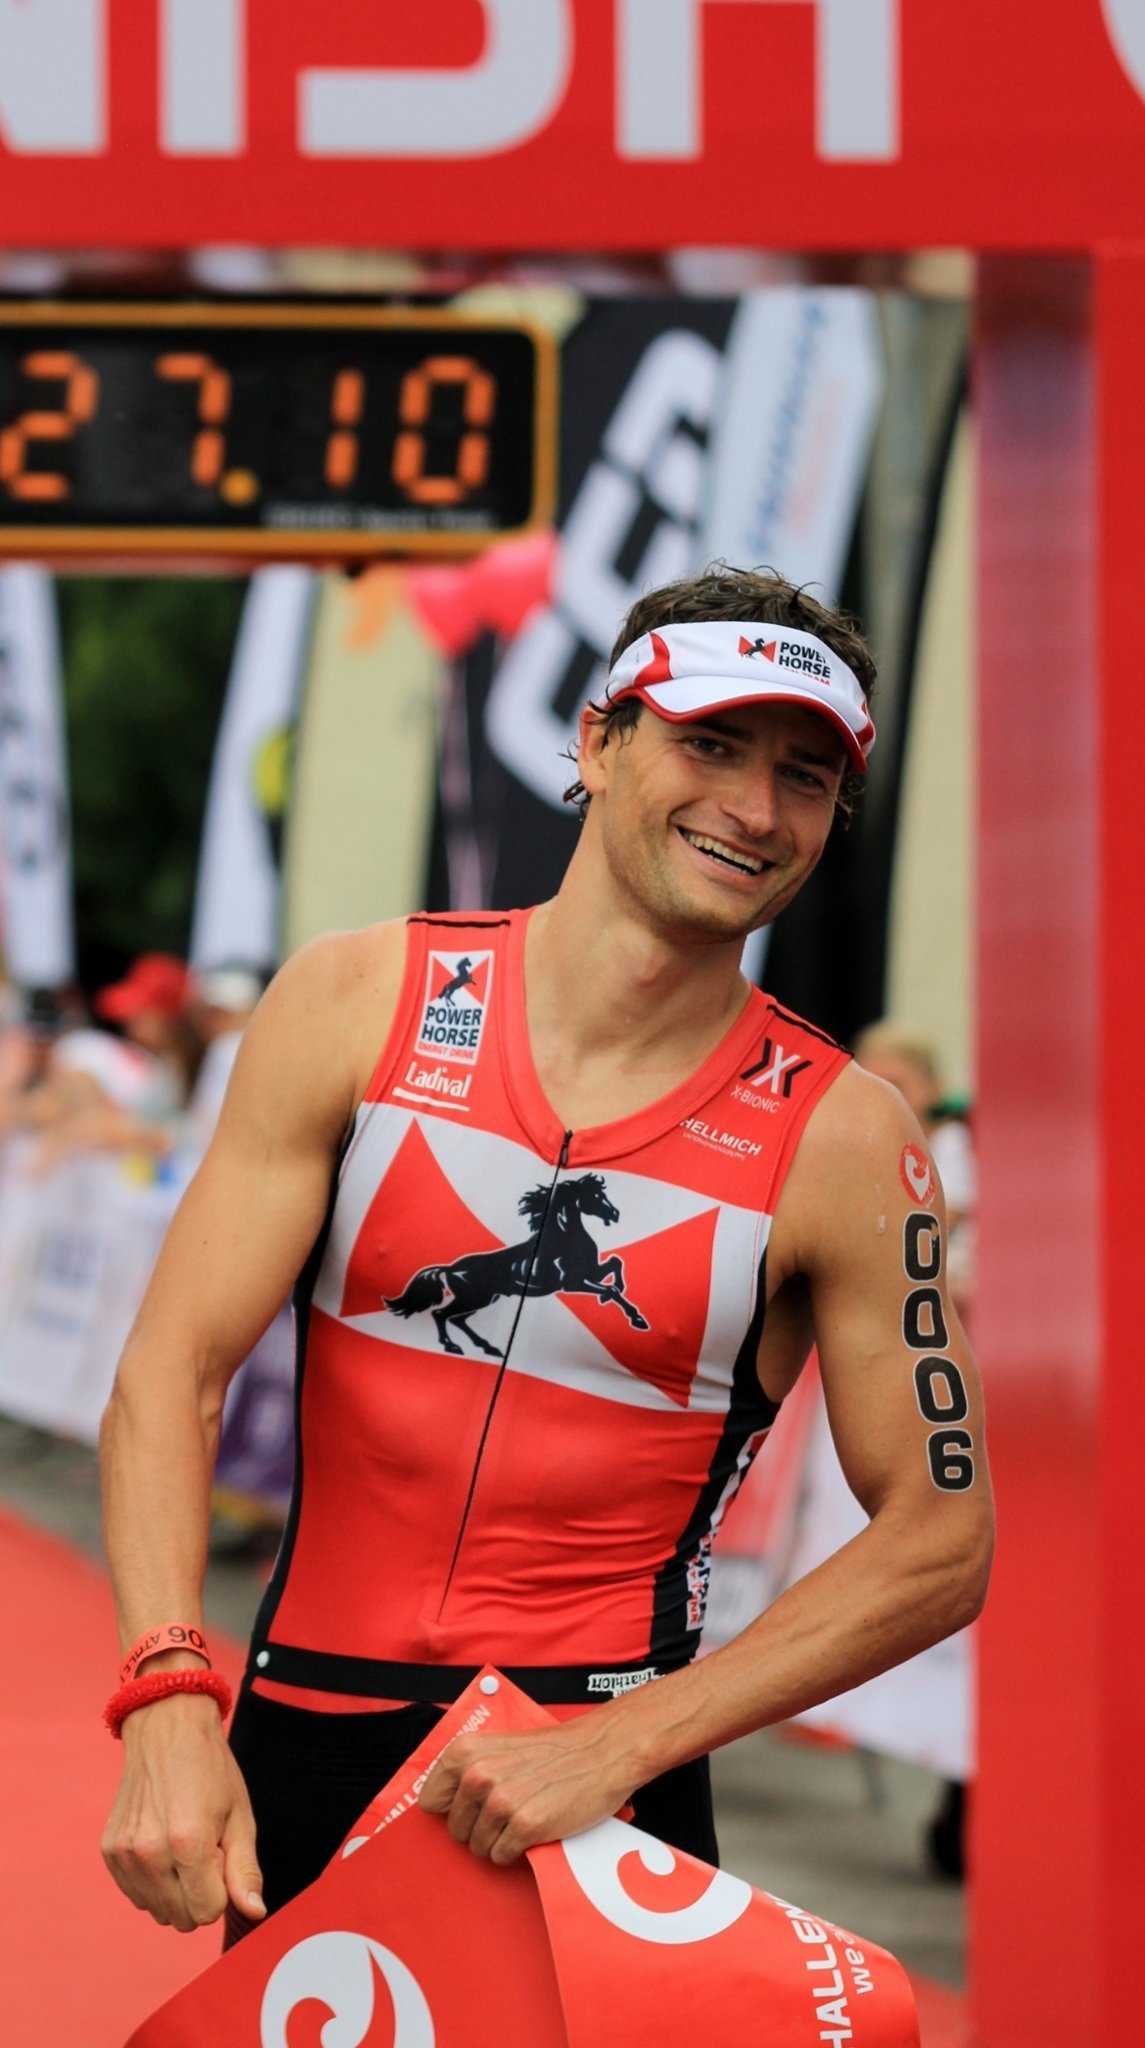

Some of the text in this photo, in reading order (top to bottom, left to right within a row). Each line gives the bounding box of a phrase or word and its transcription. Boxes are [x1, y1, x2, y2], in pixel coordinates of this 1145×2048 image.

[780, 641, 827, 663] POWE
[779, 655, 831, 678] HORSE
[425, 1005, 482, 1026] POWER
[421, 1023, 480, 1048] HORSE
[417, 1041, 475, 1060] ENERGY DRINK
[404, 1060, 473, 1098] Ladival
[730, 1084, 781, 1114] X-BIONIC
[679, 1117, 763, 1157] HELLMICH
[903, 1210, 975, 1493] 0006
